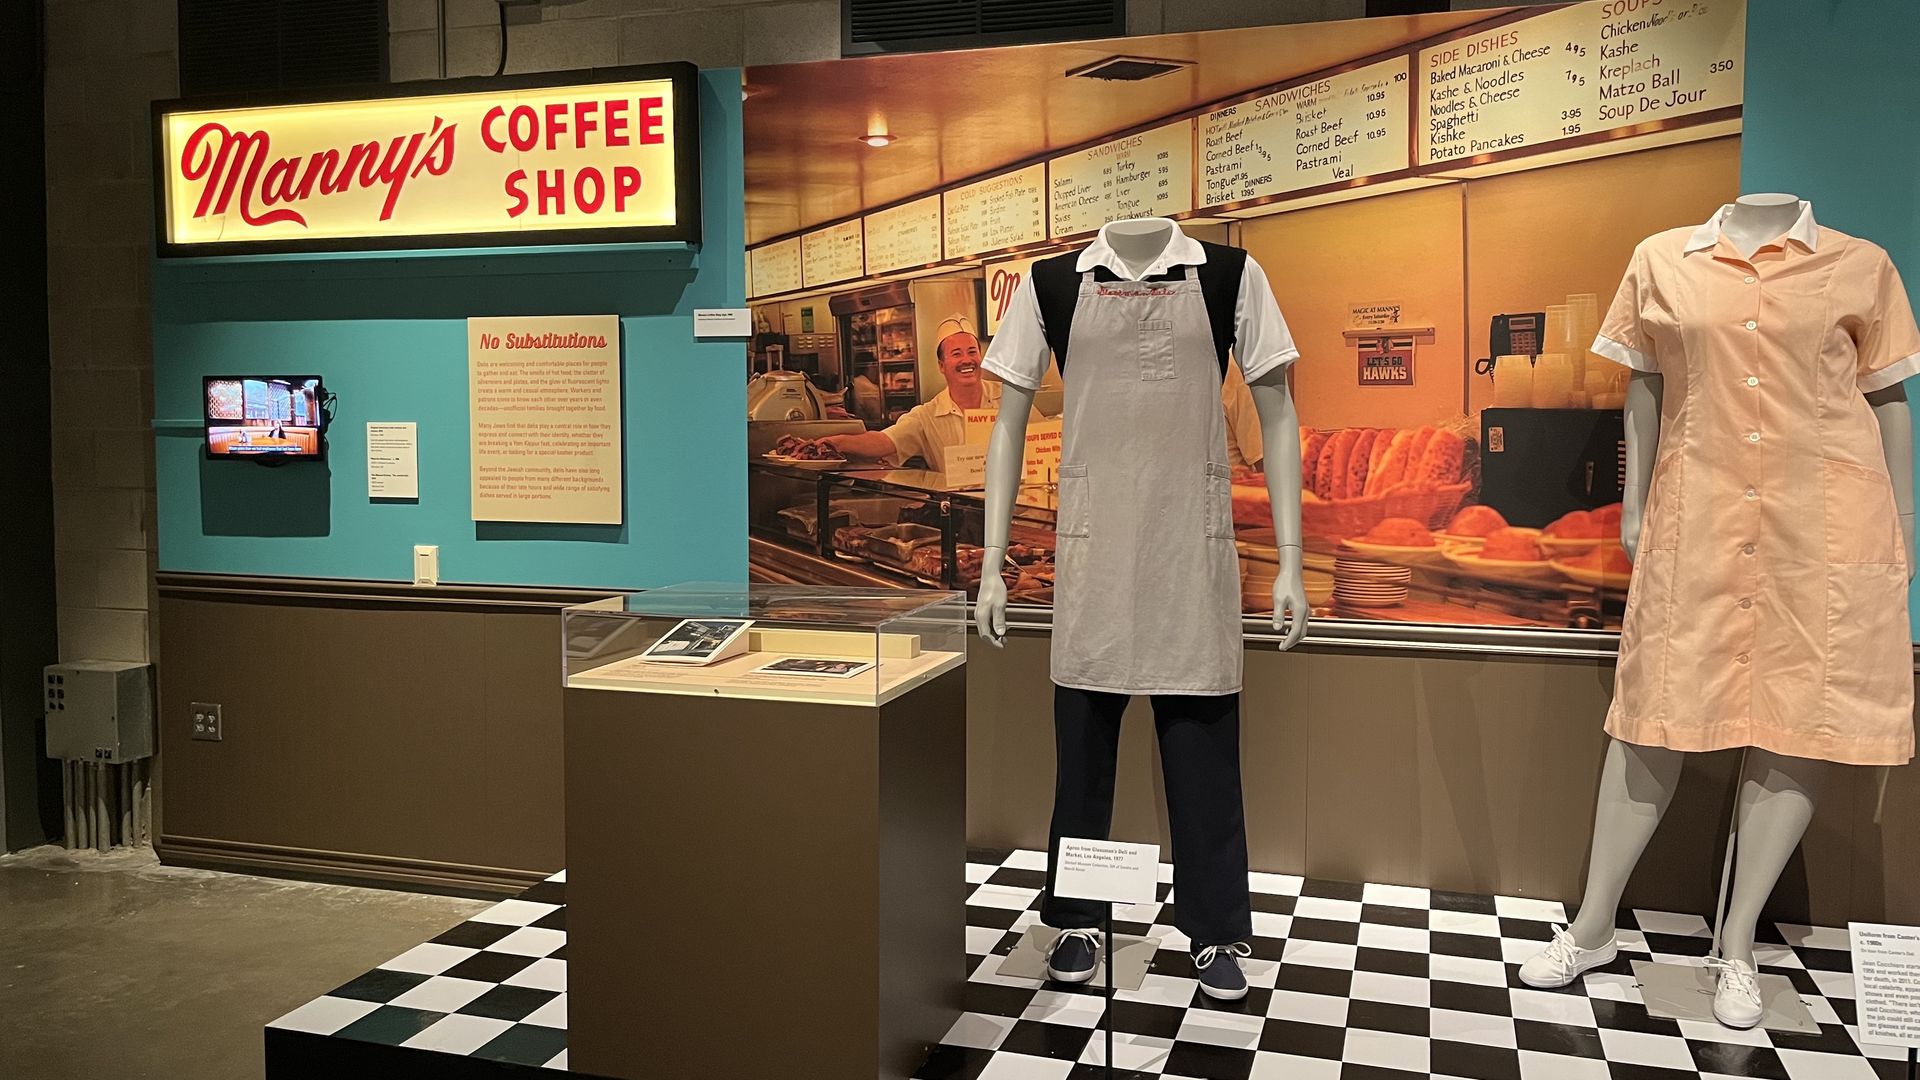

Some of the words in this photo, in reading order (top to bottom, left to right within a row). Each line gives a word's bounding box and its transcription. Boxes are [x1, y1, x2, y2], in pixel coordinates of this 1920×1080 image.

[1601, 20, 1646, 40] Chicken
[1431, 48, 1460, 68] SIDE
[1466, 30, 1519, 58] DISHES
[1600, 40, 1638, 60] Kashe
[1430, 66, 1456, 84] Baked
[1458, 55, 1500, 78] Macaroni
[1503, 55, 1510, 66] &
[1512, 45, 1550, 64] Cheese
[1600, 54, 1660, 80] Kreplach
[1430, 86, 1460, 102] Kashe
[1464, 82, 1472, 94] &
[1475, 70, 1524, 92] Noodles
[1600, 82, 1645, 101] Matzo
[1652, 68, 1680, 89] Ball
[1710, 60, 1734, 74] 350
[1255, 80, 1331, 112] SANDWICHES
[1296, 97, 1317, 110] WARM
[1367, 91, 1385, 103] 10.95
[1430, 100, 1465, 117] Noodles
[1468, 96, 1477, 108] &
[1480, 88, 1520, 106] Cheese
[1599, 104, 1634, 121] Soup
[1640, 97, 1660, 112] De
[1665, 89, 1706, 107] Jour
[1210, 107, 1237, 121] DINNERS
[1296, 125, 1318, 139] Roast
[1321, 118, 1343, 134] Beef
[1366, 108, 1386, 120] 10.95
[1430, 109, 1479, 132] Spaghetti
[481, 97, 664, 154] COFFEE
[1206, 136, 1223, 148] Roast
[1226, 129, 1243, 142] Beef
[1296, 137, 1330, 155] Corned
[1334, 130, 1359, 147] Beef
[1367, 128, 1386, 140] 10.95
[1430, 129, 1466, 146] Kishke
[1430, 144, 1466, 160] Potato
[1470, 133, 1524, 152] Pancakes
[1088, 136, 1143, 161] SANDWICHES
[1206, 146, 1233, 162] Corned
[1236, 140, 1254, 155] Beef
[1116, 160, 1136, 172] Turkey
[1206, 158, 1242, 176] Pastrami
[1296, 151, 1342, 171] Pastrami
[181, 116, 458, 229] Manny's
[1116, 170, 1151, 185] Hamburger
[1245, 174, 1273, 188] DINNERS
[1332, 164, 1354, 179] Veal
[504, 166, 642, 218] SHOP
[1054, 176, 1073, 189] Salami
[1206, 176, 1236, 190] Tongue
[1078, 194, 1100, 206] Cheese
[1206, 190, 1235, 204] Brisket
[1055, 213, 1071, 224] Swiss
[1055, 225, 1073, 236] Cream
[480, 334, 500, 349] No
[506, 332, 607, 349] Substitutions
[1367, 357, 1389, 366] LET'S
[1392, 356, 1402, 366] GO
[1363, 367, 1407, 380] HAWKS
